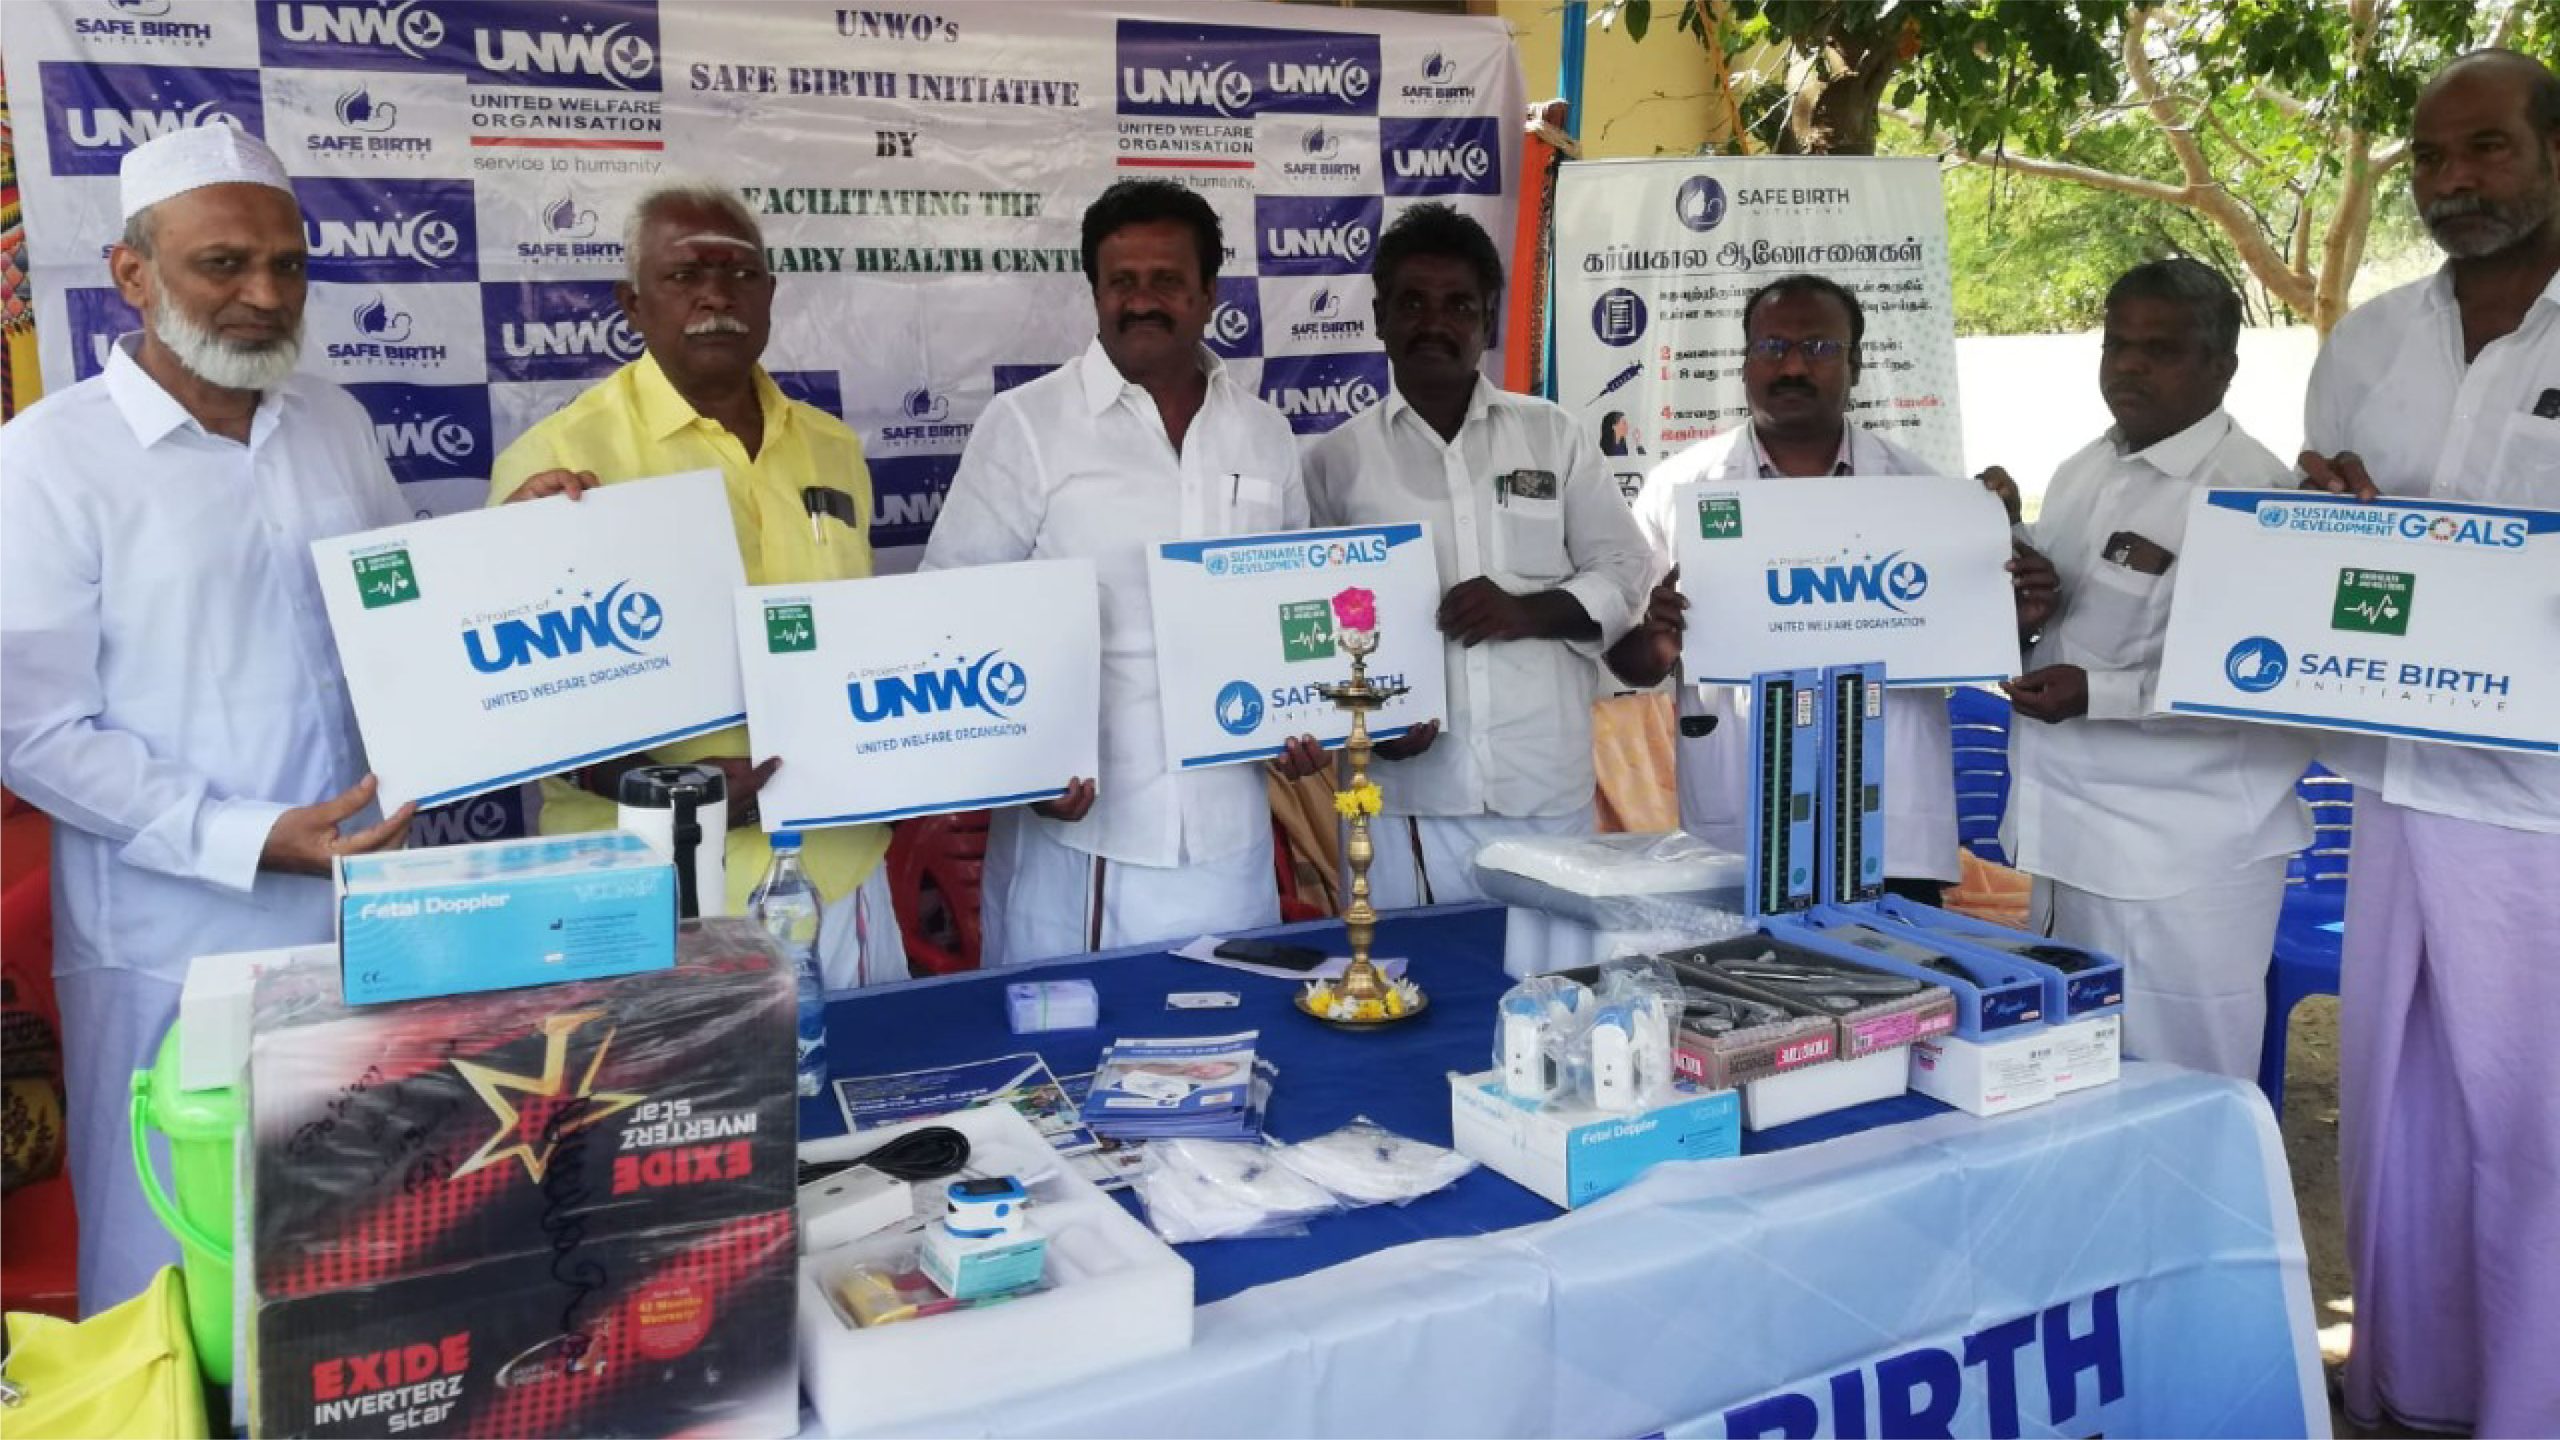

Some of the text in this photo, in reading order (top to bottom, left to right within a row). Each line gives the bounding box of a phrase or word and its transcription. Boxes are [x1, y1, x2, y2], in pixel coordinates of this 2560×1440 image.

[75, 18, 212, 39] SAFE BIRTH
[474, 22, 653, 90] UNWO
[691, 63, 1080, 106] SAFE BIRTH INITIATIVE
[1124, 60, 1253, 117] UNWO
[1269, 57, 1369, 104] UNWO
[1402, 86, 1475, 99] SAFE BIRTH
[471, 94, 662, 115] UNITED WELFARE
[472, 113, 662, 132] ORGANISATION
[1118, 122, 1254, 140] UNITED WELFARE
[308, 135, 432, 153] SAFE BIRTH
[875, 131, 918, 158] BY
[1118, 137, 1254, 154] ORGANISATION
[473, 158, 544, 172] service
[551, 157, 568, 173] to
[1284, 163, 1361, 176] SAFE BIRTH
[1394, 140, 1490, 183] UNWO
[977, 192, 1042, 218] THE
[1737, 188, 1849, 206] SAFE BIRTH
[517, 242, 569, 258] SAFE
[1268, 220, 1369, 264] UNWO
[1583, 236, 1923, 275] கர்ப்பகால ஆலோசனைகள்
[855, 247, 984, 273] HEALTH
[503, 309, 645, 364] UNWO
[1291, 320, 1364, 336] SAFE BIRTH
[327, 343, 447, 361] SAFE BIRTH
[882, 426, 925, 441] SAFE
[2290, 519, 2396, 537] DEVELOPMENT
[2292, 507, 2526, 549] SUSTAINABLE GOALS
[1230, 539, 1388, 568] SUSTAINABLE GOALS
[1231, 555, 1305, 575] DEVELOPMENT
[1766, 550, 1929, 614] UNWO
[2343, 571, 2355, 586] 3
[461, 578, 664, 676] UNWO
[1768, 616, 1926, 633] UNITED WELFARE ORGANISATION
[481, 655, 671, 711] UNITED WELFARE ORGANISATION
[847, 648, 1027, 723] UNWO
[2299, 653, 2511, 697] SAFE BIRTH
[2295, 680, 2507, 712] INITIATIVE
[856, 723, 1027, 756] UNITED WELFARE ORGANISATION
[360, 892, 511, 921] Fetal Doppler
[627, 1098, 692, 1124] star
[619, 1111, 758, 1151] INVERTERZ
[1581, 1119, 1659, 1146] Fetal Doppler
[612, 1138, 753, 1195] EXIDE
[312, 1330, 471, 1402] EXIDE
[314, 1374, 465, 1426] INVERTERZ
[388, 1401, 456, 1434] star
